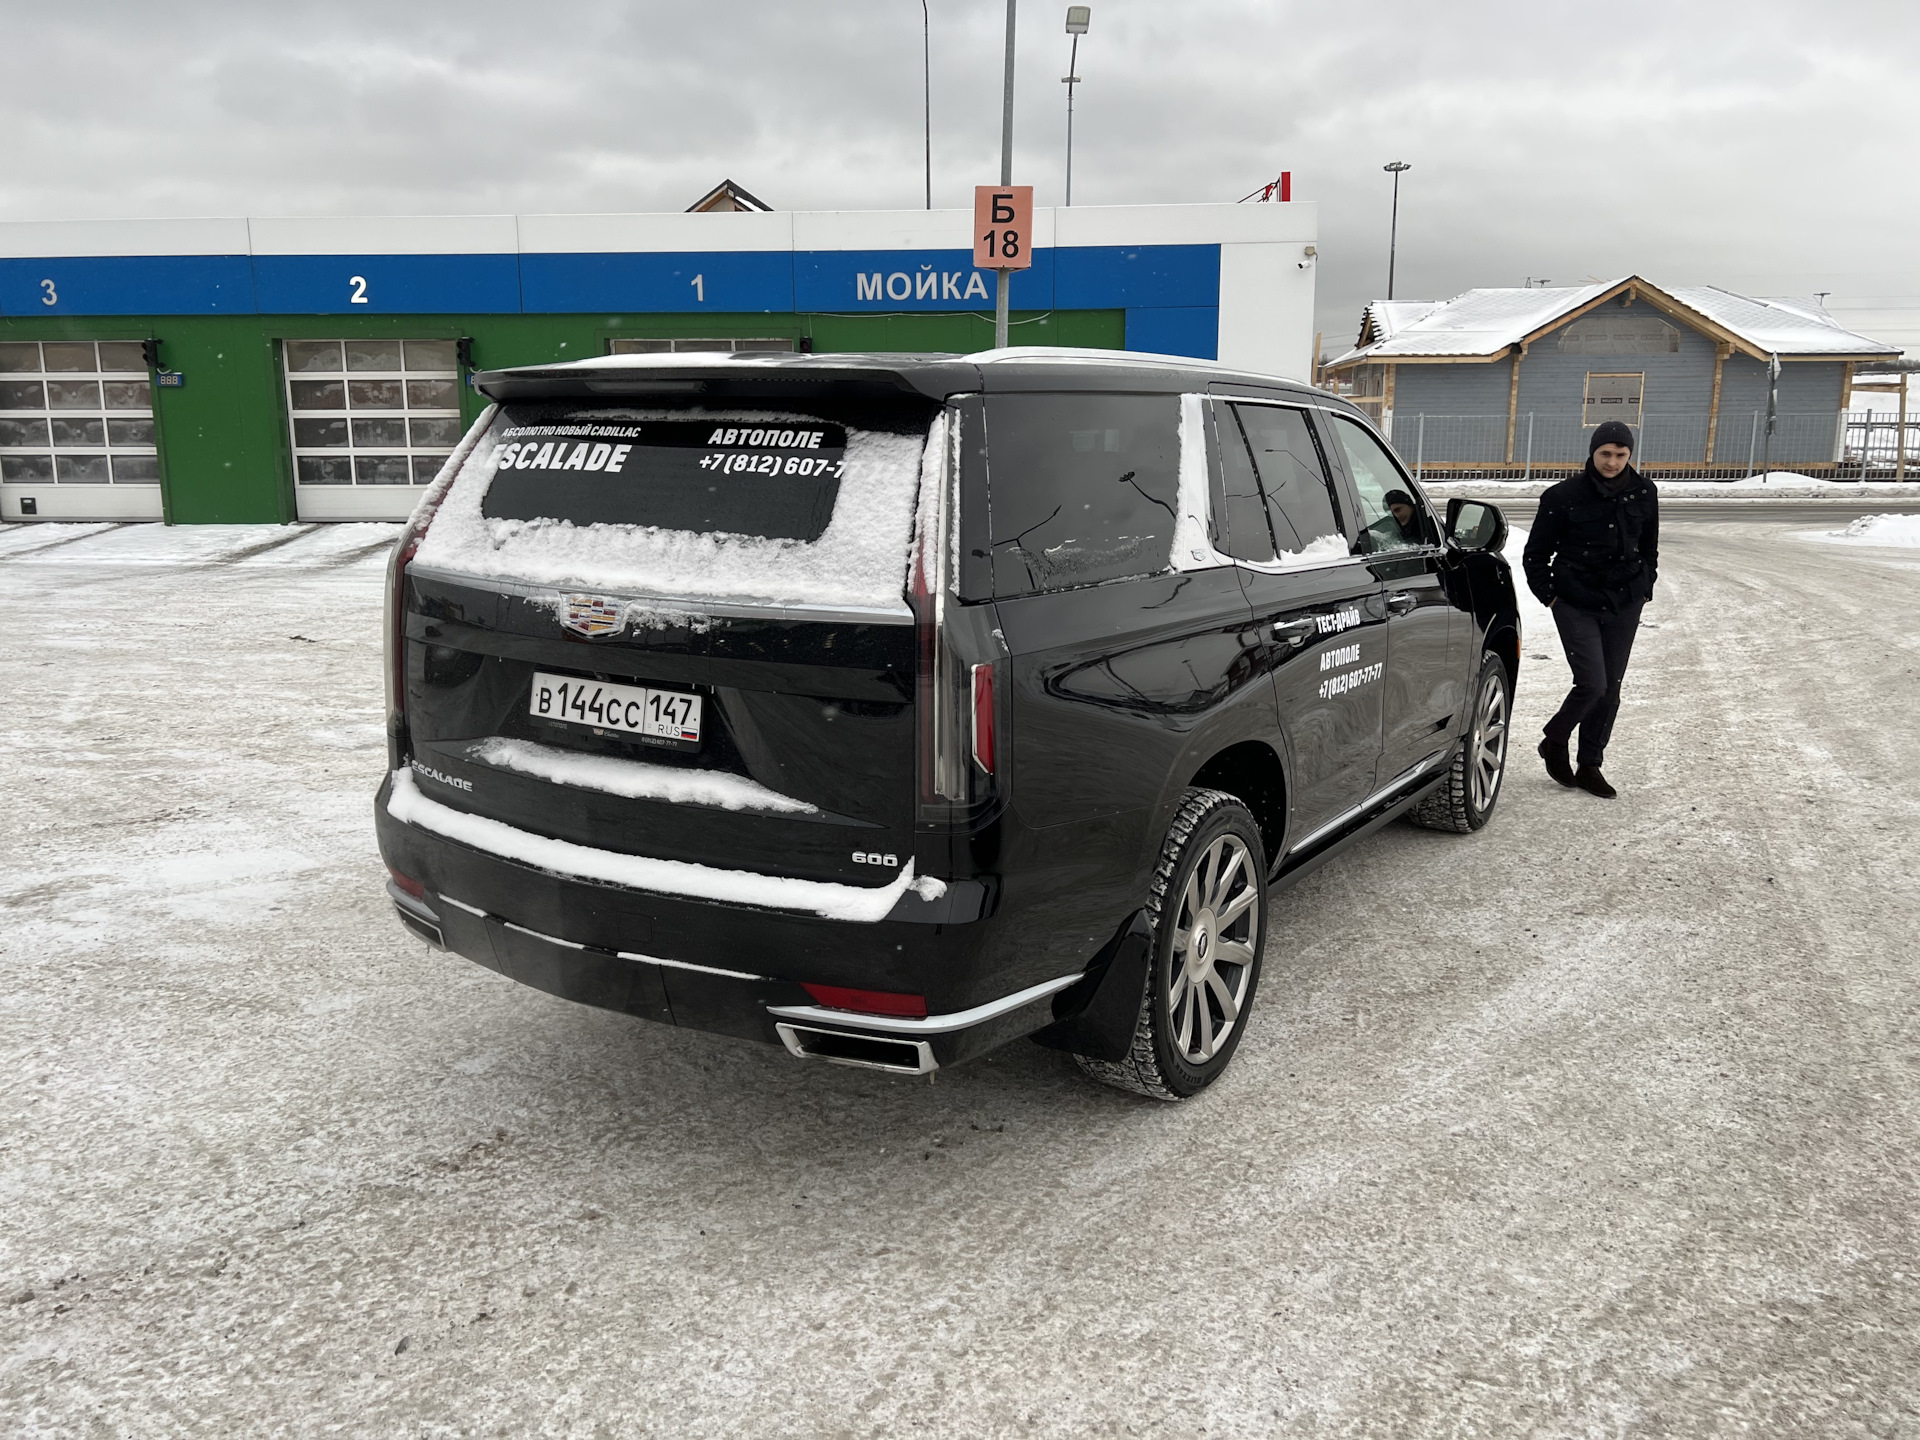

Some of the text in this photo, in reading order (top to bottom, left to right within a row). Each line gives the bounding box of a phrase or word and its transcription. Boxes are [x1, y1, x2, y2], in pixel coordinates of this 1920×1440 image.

[991, 193, 1015, 224] Б
[983, 230, 1019, 259] 18
[40, 279, 58, 306] 3
[349, 275, 368, 304] 2
[690, 274, 704, 302] 1
[856, 264, 989, 301] МОЙКА
[501, 423, 642, 438] АБСОЛЮТНО НОВЫЙ CADILLAC
[707, 428, 824, 449] АВТОПОЛЕ
[1315, 605, 1361, 634] ТЕСТ-ДРАЙВ
[1320, 643, 1361, 672] АВТОПОЛЕ
[649, 694, 694, 726] 147
[657, 723, 681, 738] RUS
[411, 759, 473, 792] ESCALADE
[851, 850, 898, 867] 600
